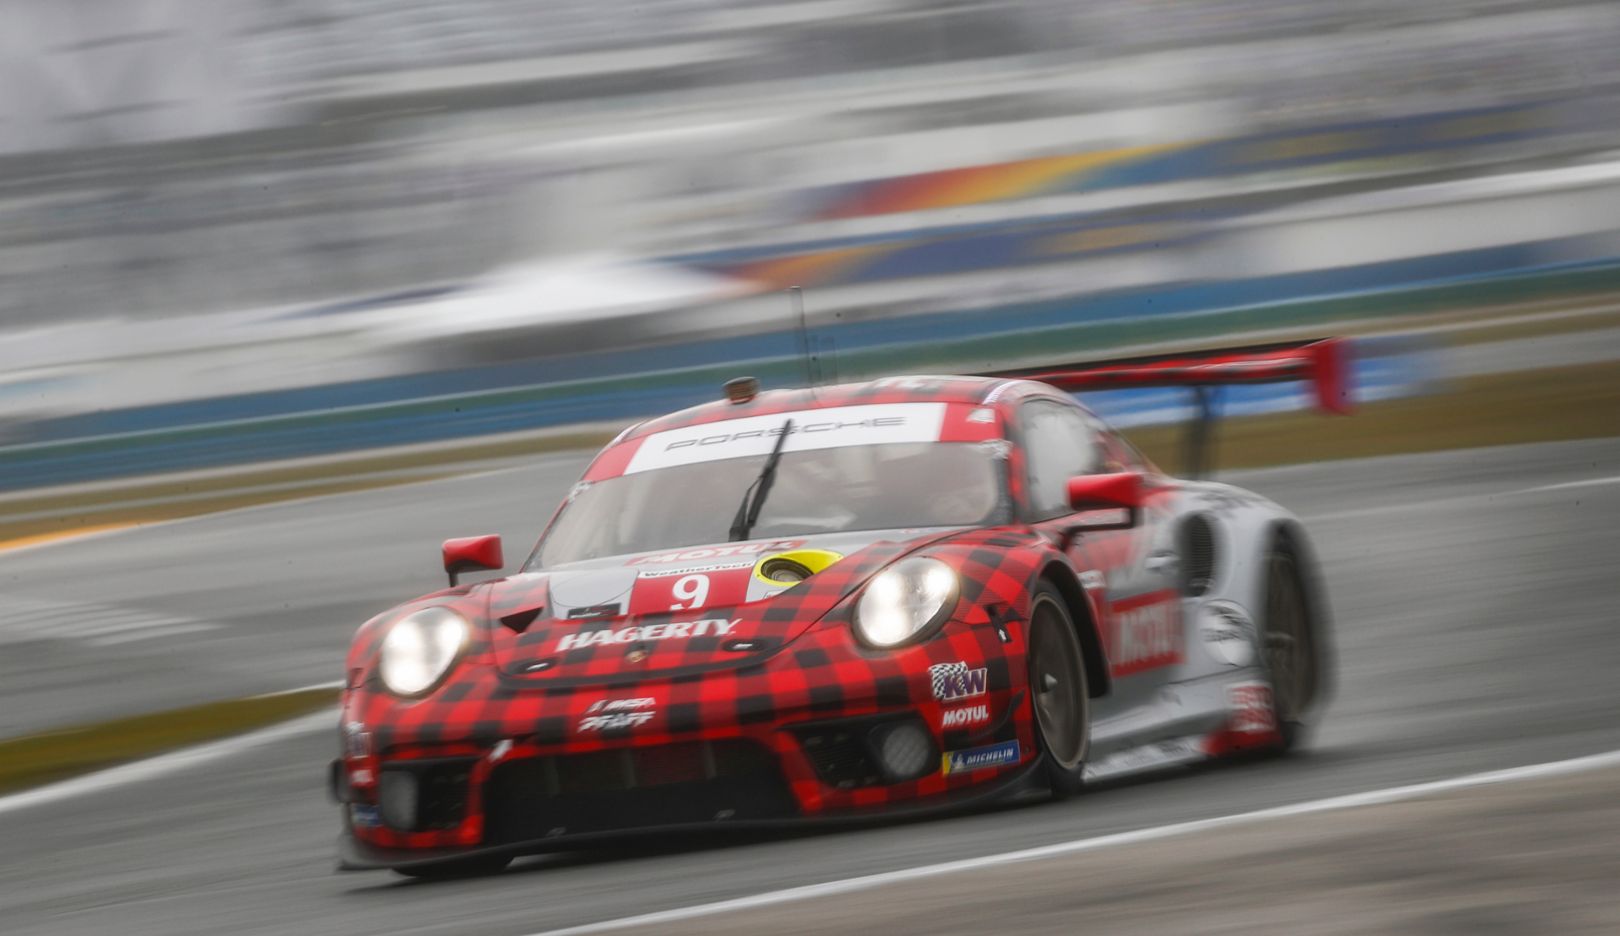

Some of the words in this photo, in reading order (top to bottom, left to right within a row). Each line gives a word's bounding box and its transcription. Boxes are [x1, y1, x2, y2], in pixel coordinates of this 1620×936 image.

[664, 415, 909, 452] PORSCHE
[670, 574, 710, 611] 9
[556, 618, 742, 652] HAGERTY
[943, 667, 987, 700] KW
[941, 704, 990, 728] MOTUL
[966, 747, 1014, 767] MICHELIN
